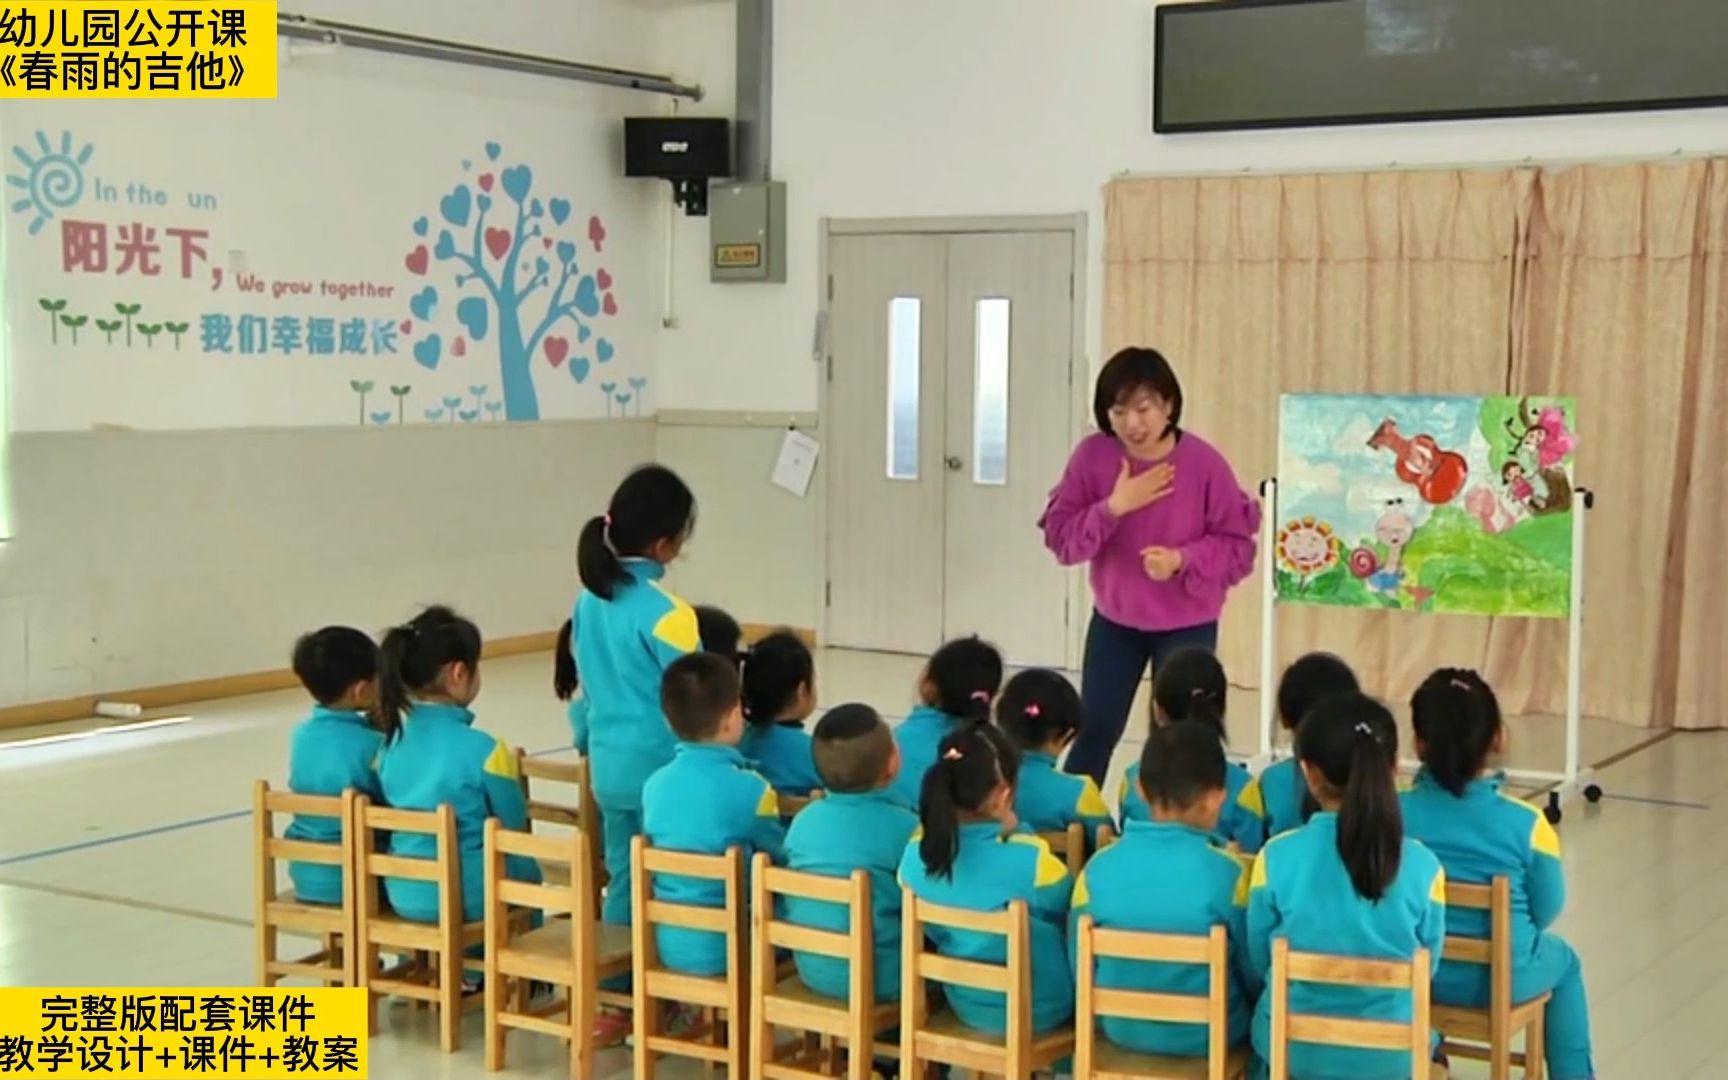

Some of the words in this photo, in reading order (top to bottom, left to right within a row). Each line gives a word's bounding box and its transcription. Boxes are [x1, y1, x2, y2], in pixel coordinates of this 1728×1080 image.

[94, 177, 118, 202] In
[126, 182, 168, 206] the
[236, 272, 265, 294] We
[271, 280, 313, 300] grow
[320, 280, 395, 301] together
[200, 313, 398, 355] 我们幸福成长
